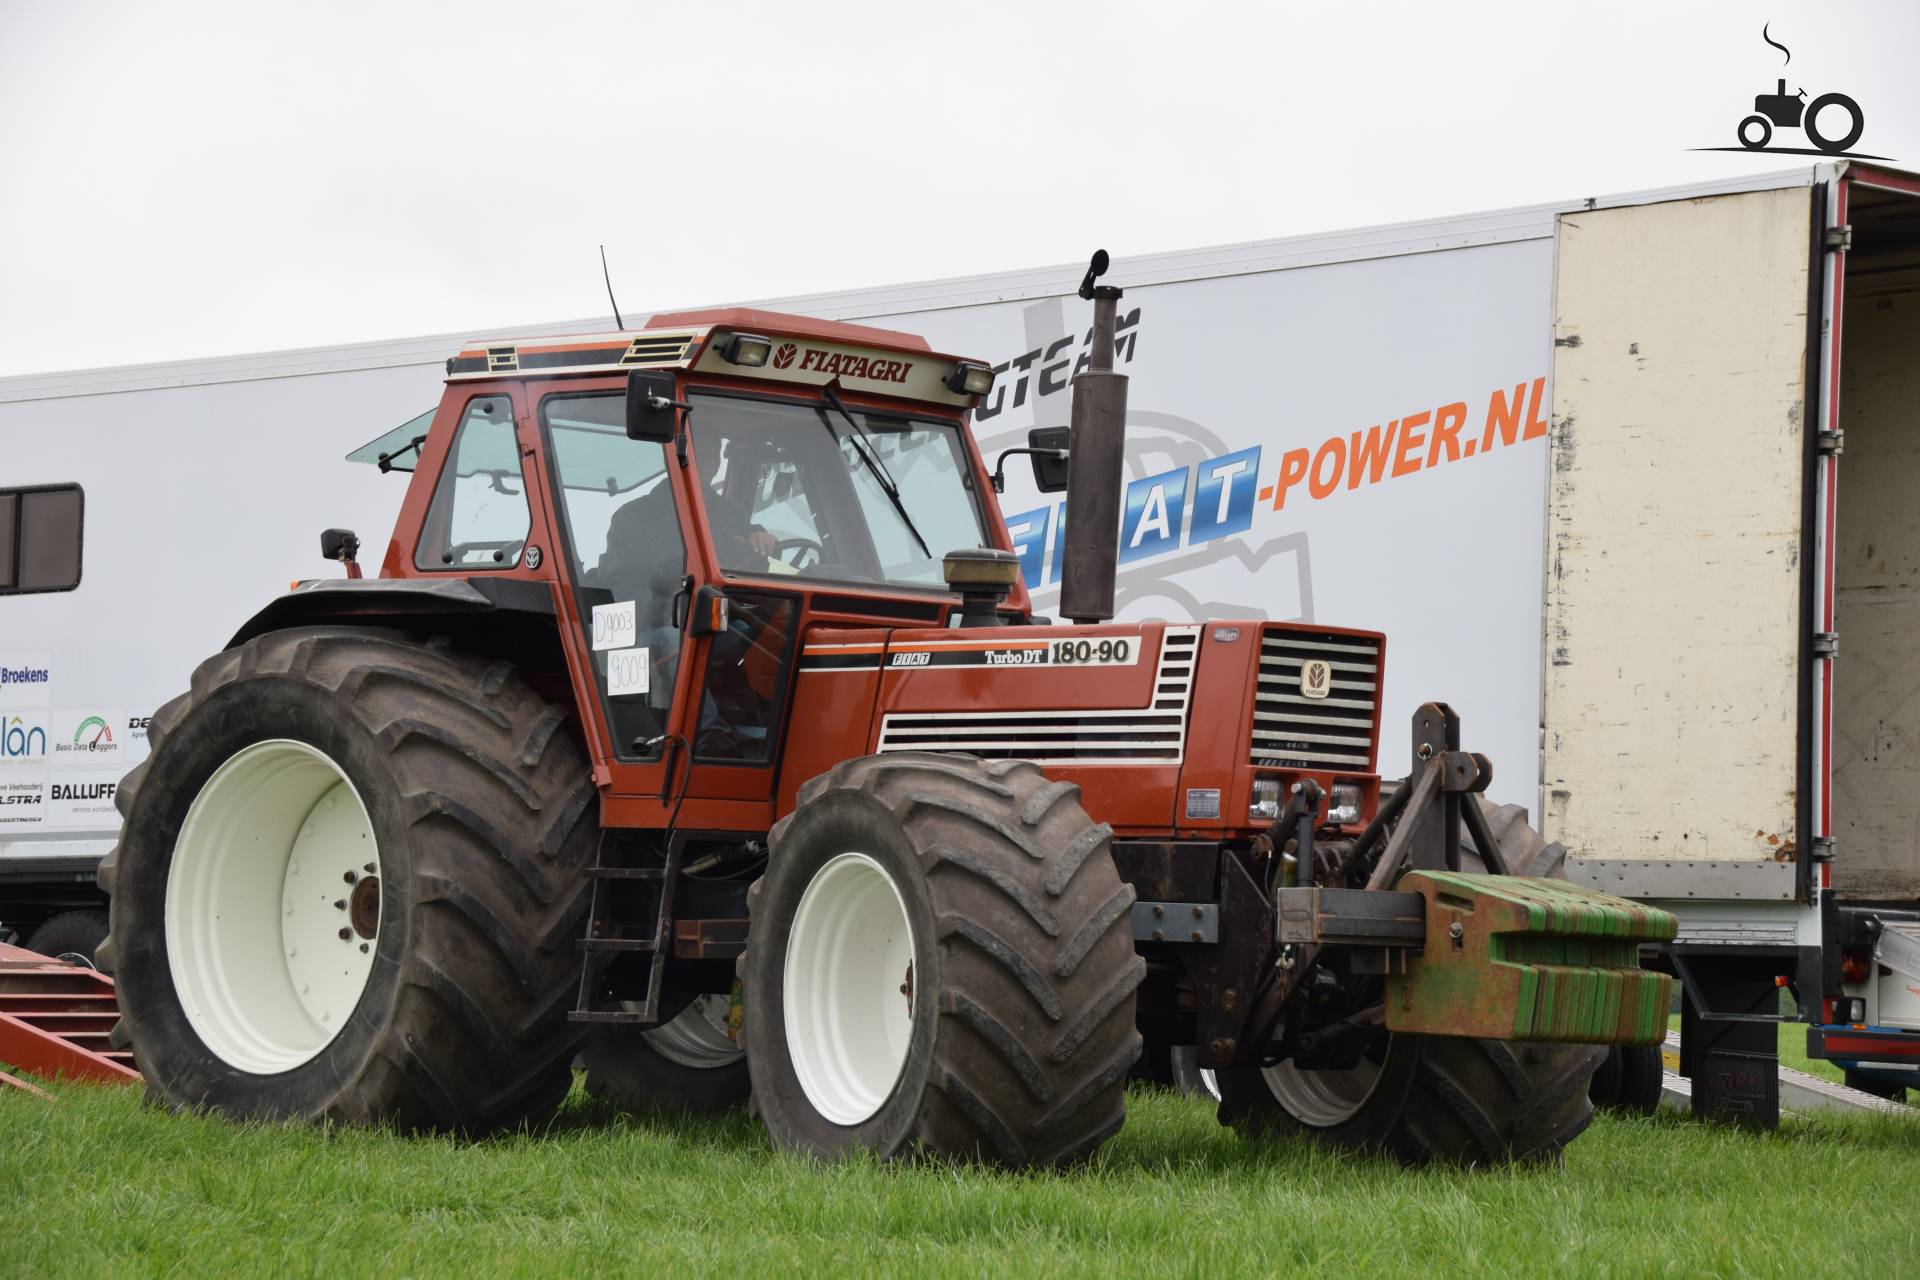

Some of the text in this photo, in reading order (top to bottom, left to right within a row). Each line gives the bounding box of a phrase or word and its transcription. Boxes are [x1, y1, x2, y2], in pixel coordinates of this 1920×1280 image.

[798, 349, 914, 383] FIATAGRI
[1009, 376, 1548, 556] FAT-POWER.NL
[892, 652, 930, 666] FIAT
[1052, 639, 1130, 664] 180-90
[1, 666, 48, 684] Broekens
[128, 717, 152, 729] DE
[56, 741, 118, 752] Basic Data Loggers
[51, 783, 116, 800] BALLUFF
